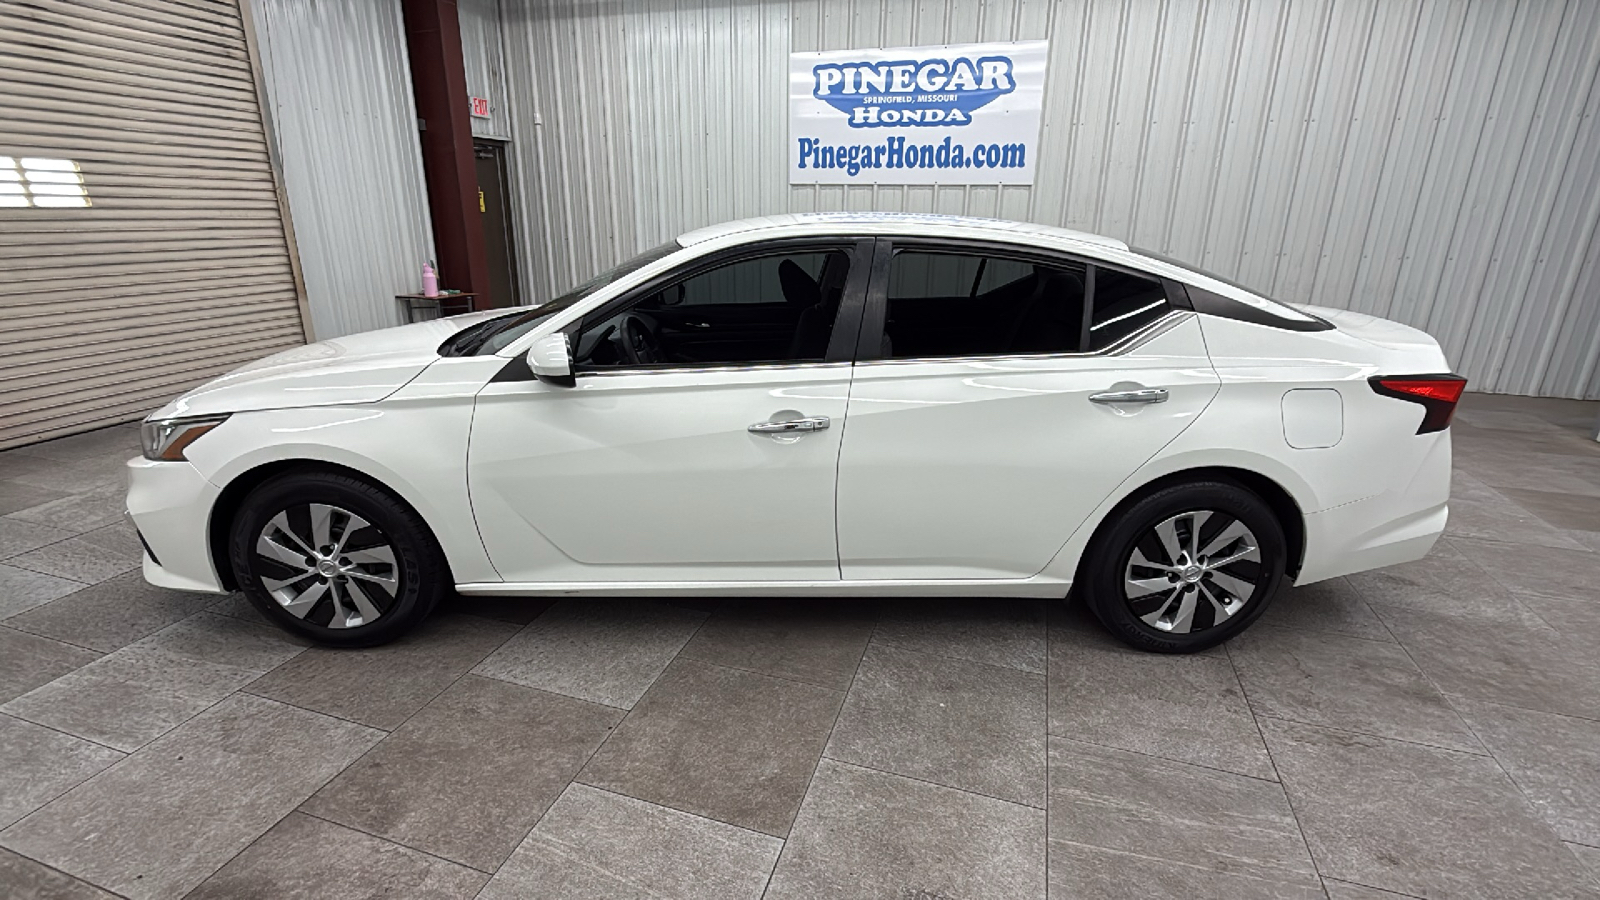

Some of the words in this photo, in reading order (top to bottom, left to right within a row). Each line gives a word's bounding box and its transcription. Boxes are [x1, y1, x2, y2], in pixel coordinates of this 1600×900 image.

[816, 60, 1012, 95] PINEGAR
[863, 96, 915, 104] SPRINGFIELD,
[917, 95, 957, 103] MISSOURI
[798, 136, 1026, 176] PinegarHonda.com
